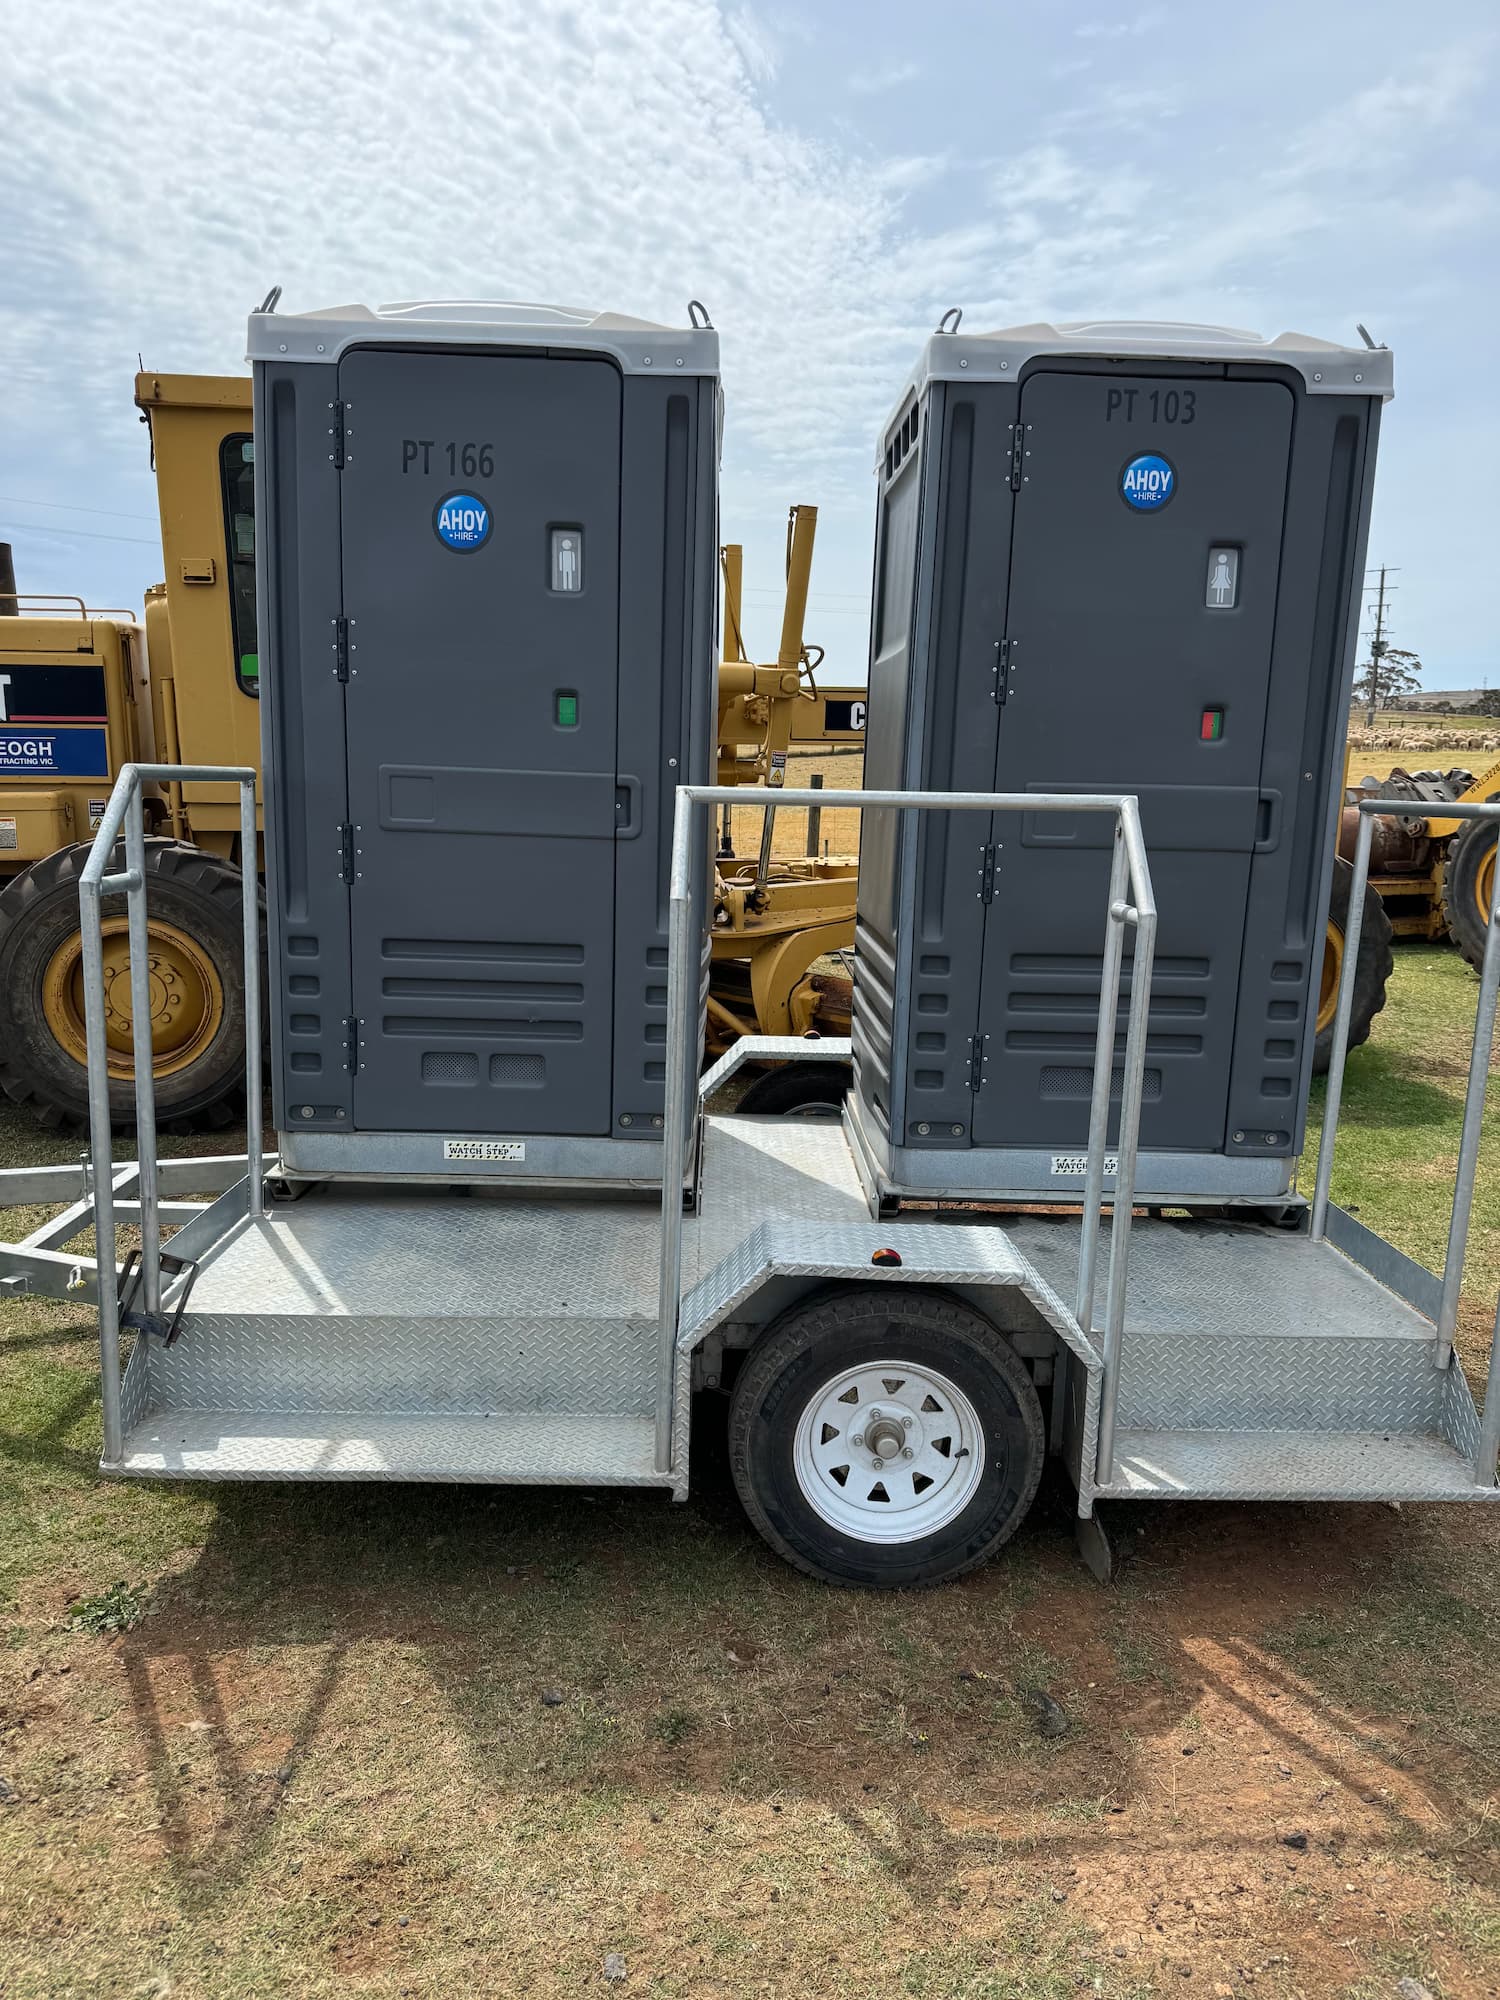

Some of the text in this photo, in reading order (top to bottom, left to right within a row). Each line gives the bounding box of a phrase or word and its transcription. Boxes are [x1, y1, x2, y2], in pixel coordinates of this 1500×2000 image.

[1106, 388, 1196, 425] PT 103
[402, 439, 494, 478] PT 166
[1123, 469, 1172, 492] AHOY
[1138, 492, 1157, 501] HIRE
[439, 509, 487, 532] AHOY
[454, 531, 474, 541] HIRE
[40, 758, 53, 766] VIC
[449, 1147, 509, 1156] WATCH STEP
